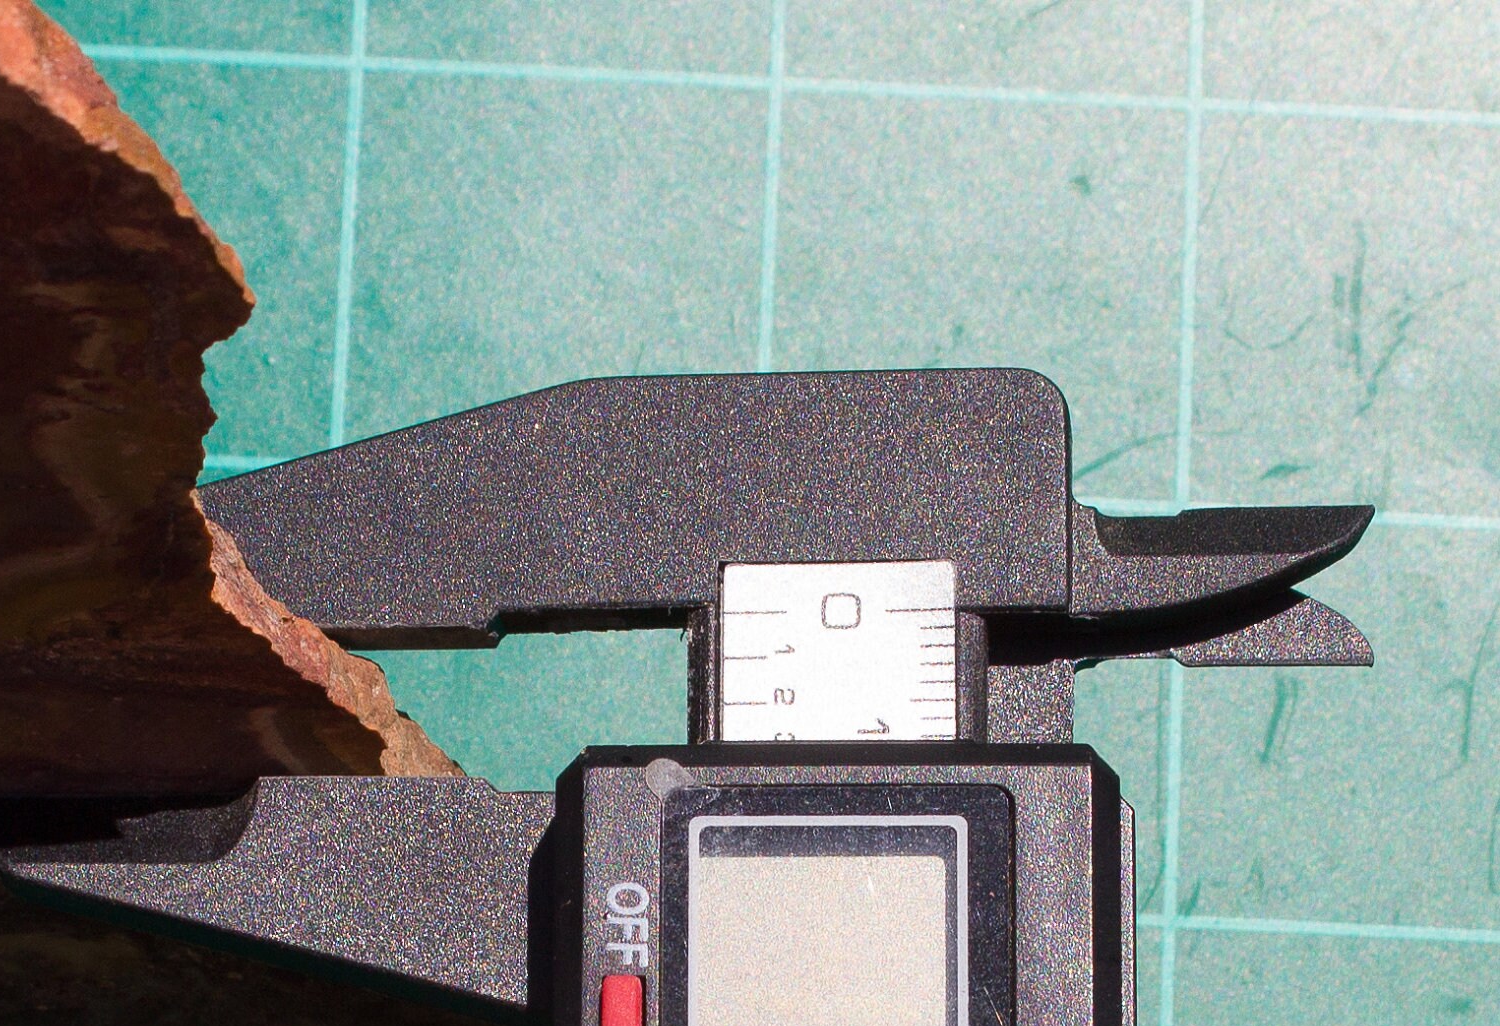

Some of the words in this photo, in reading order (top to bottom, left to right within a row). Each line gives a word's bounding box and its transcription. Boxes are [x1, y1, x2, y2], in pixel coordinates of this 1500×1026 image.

[821, 592, 861, 629] 0
[773, 687, 796, 706] 2
[605, 880, 650, 968] OFF
